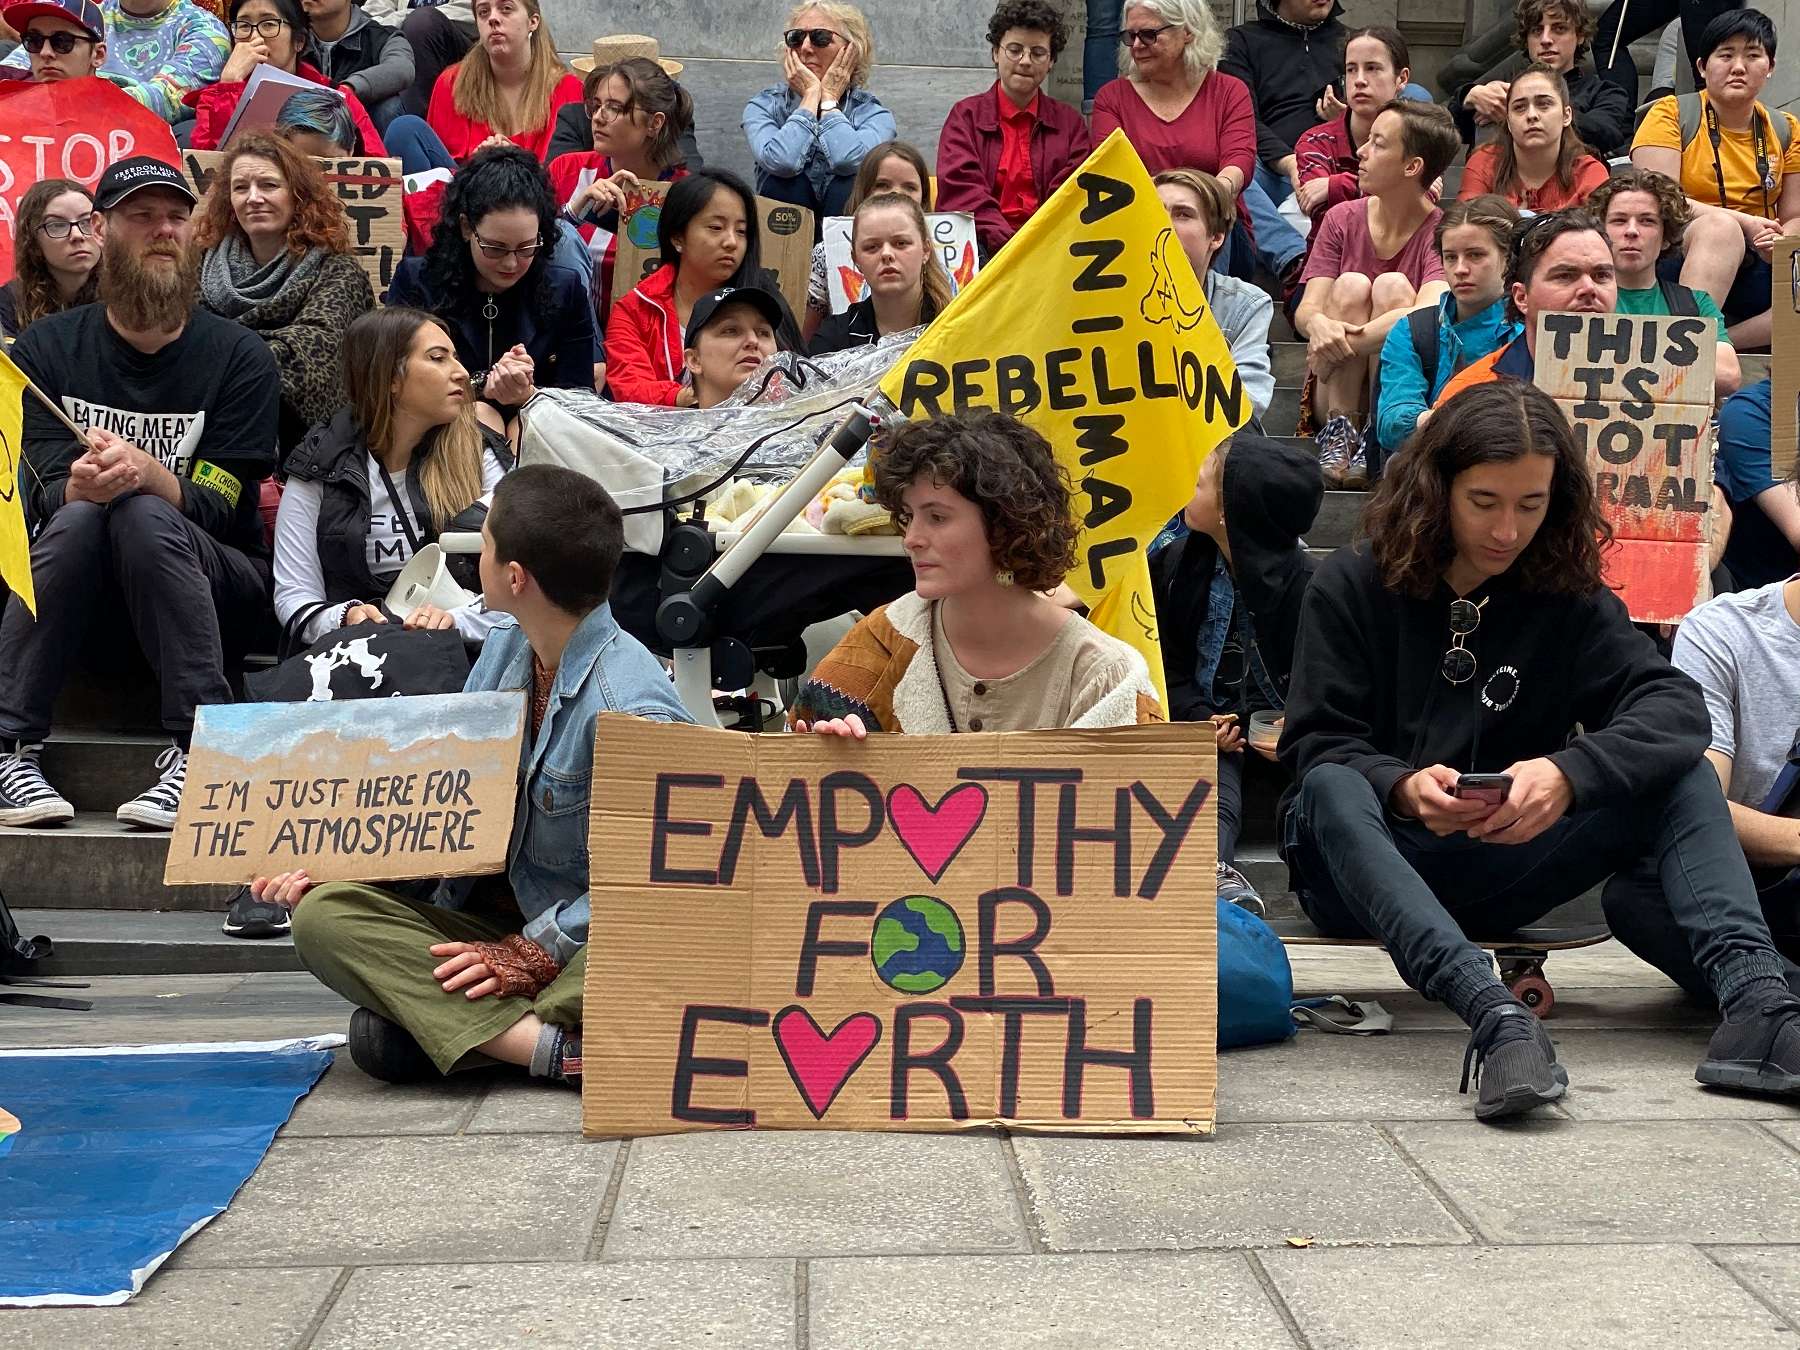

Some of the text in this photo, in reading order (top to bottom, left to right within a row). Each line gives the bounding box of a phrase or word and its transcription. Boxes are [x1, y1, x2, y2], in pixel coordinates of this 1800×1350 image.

[115, 164, 157, 180] FREEDOM
[775, 211, 796, 223] 50%
[1544, 314, 1706, 367] THIS
[899, 340, 1242, 429] REBELLION
[1068, 171, 1138, 590] ANIMAL
[1573, 367, 1660, 420] IS
[74, 401, 137, 437] EATING
[200, 769, 473, 812] I'M JUST HERE FOR
[189, 809, 482, 857] THE ATMOSPHERE
